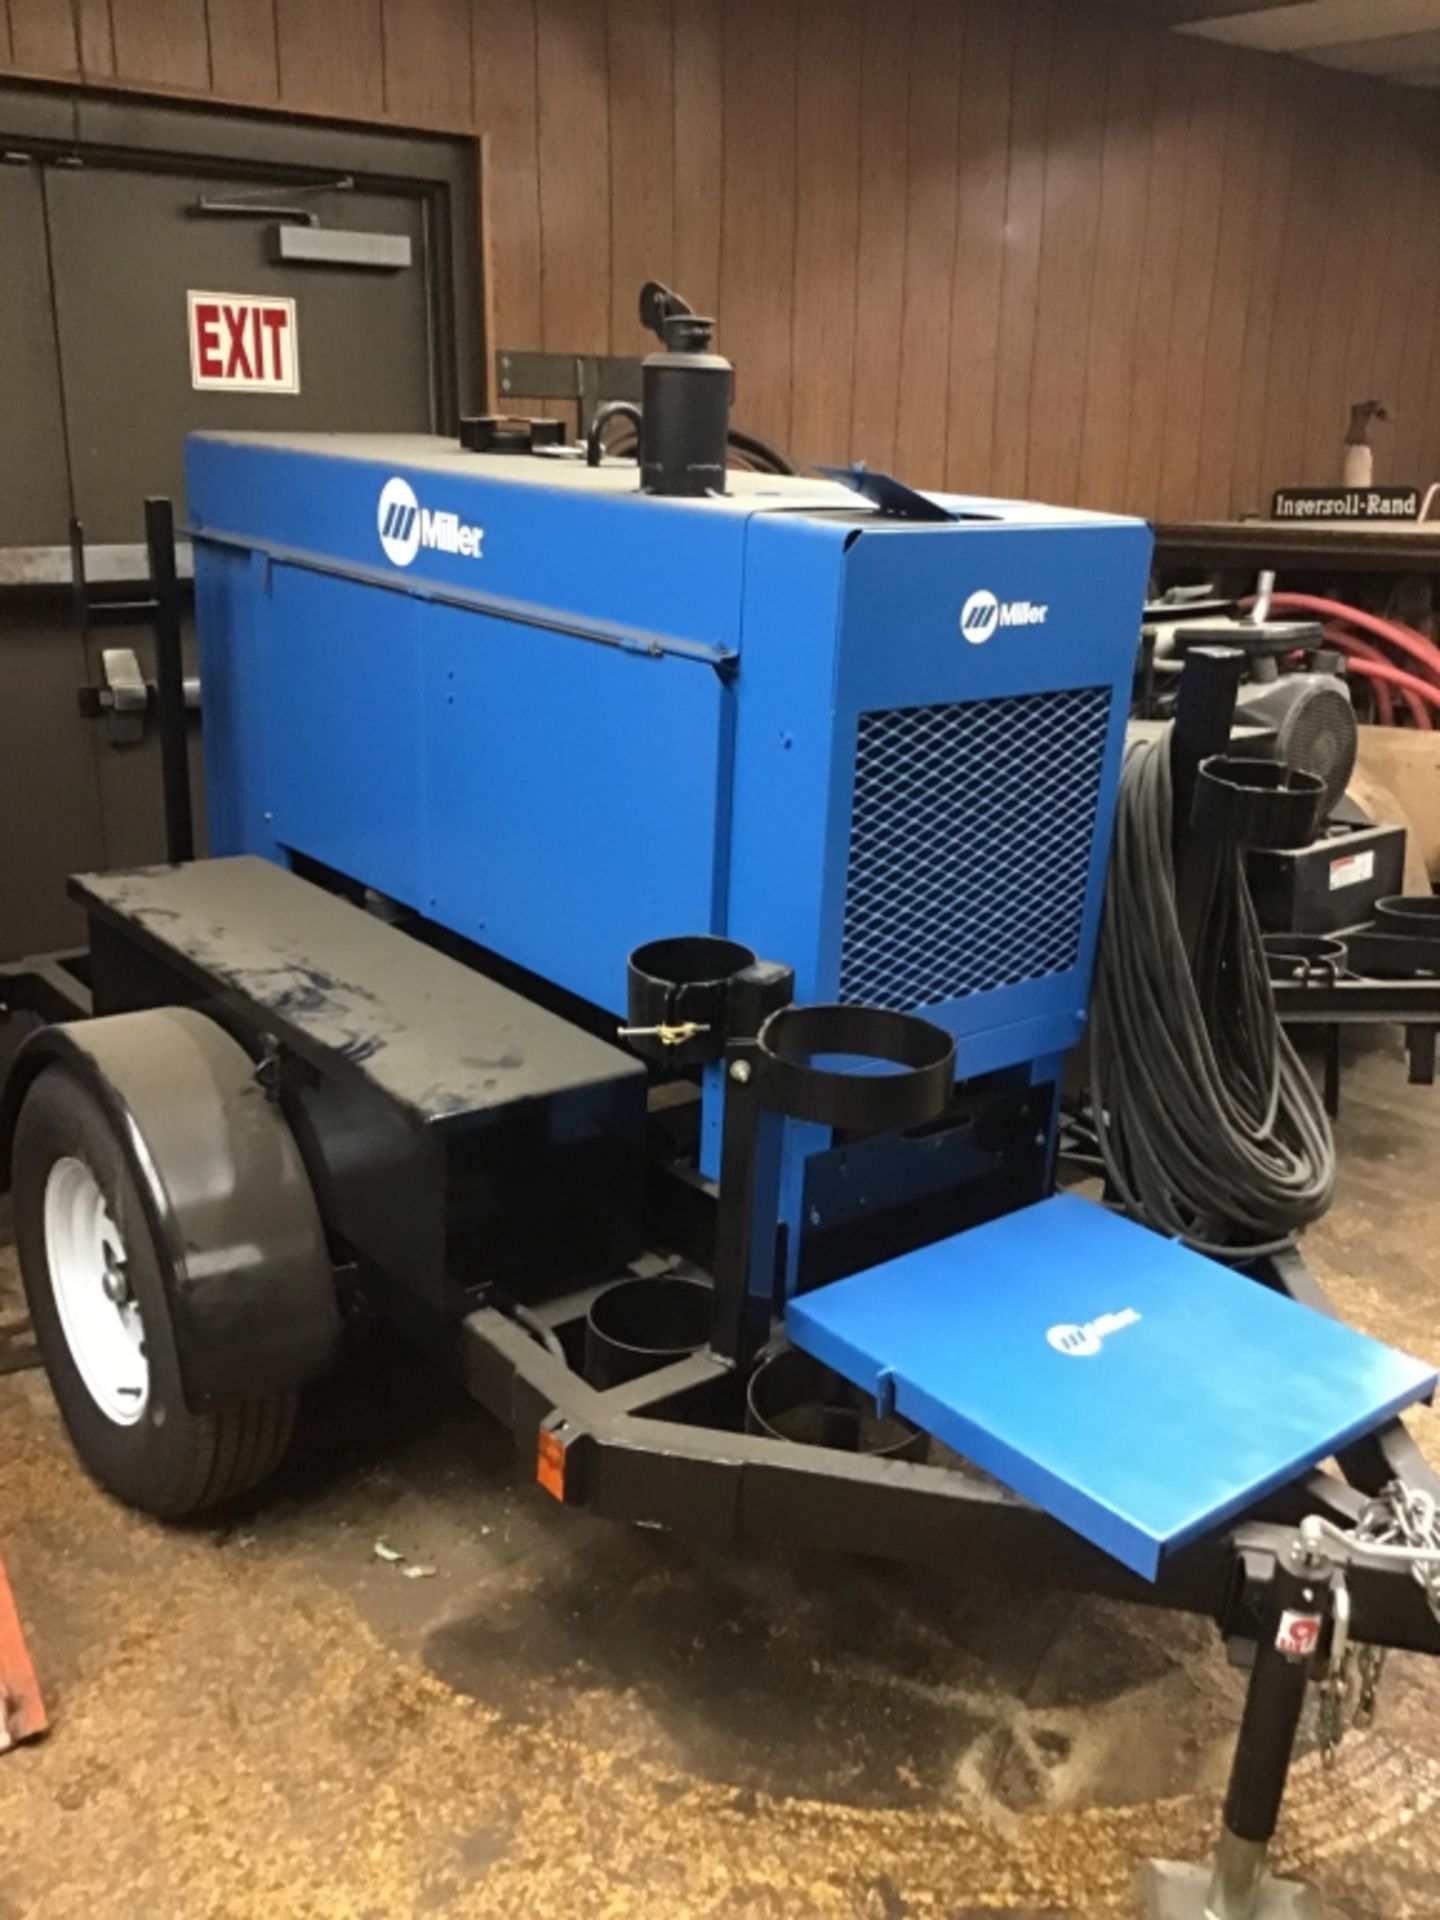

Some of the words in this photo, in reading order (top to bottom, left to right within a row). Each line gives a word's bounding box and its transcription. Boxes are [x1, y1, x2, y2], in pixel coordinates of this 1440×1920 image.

[195, 303, 287, 381] EXIT
[420, 507, 484, 558] Miller
[999, 601, 1048, 627] Miller
